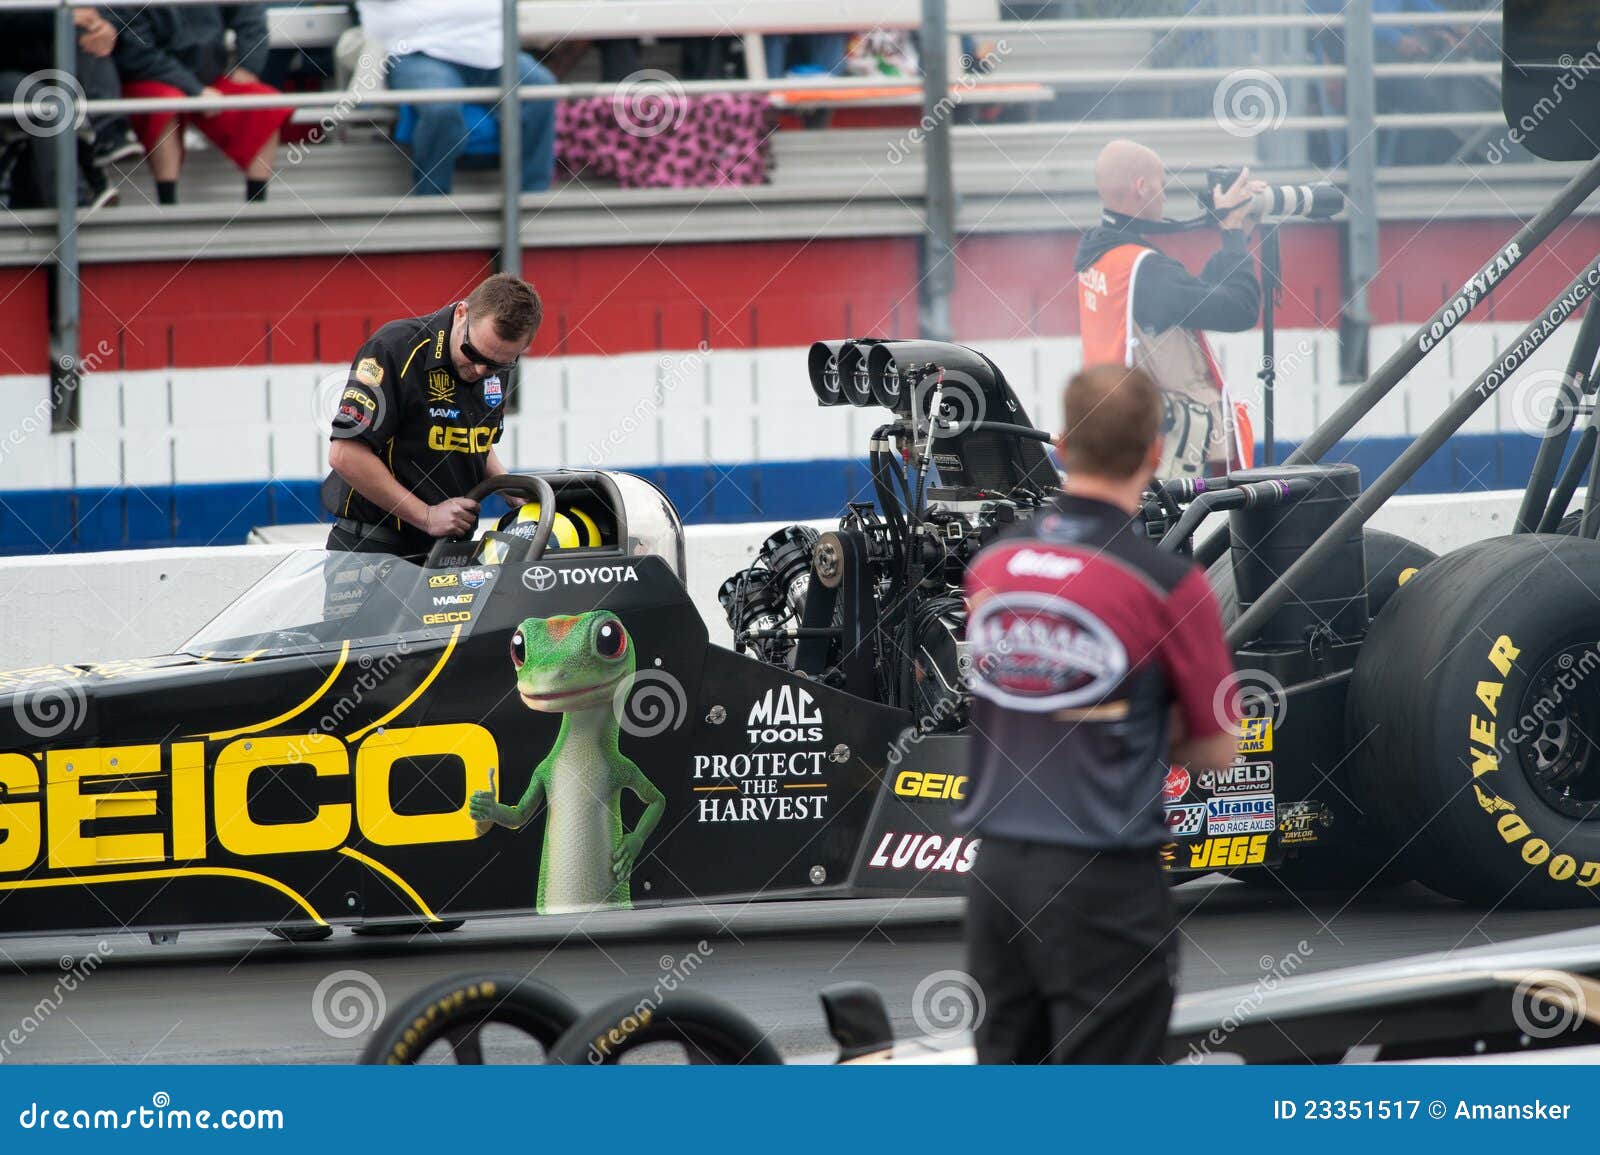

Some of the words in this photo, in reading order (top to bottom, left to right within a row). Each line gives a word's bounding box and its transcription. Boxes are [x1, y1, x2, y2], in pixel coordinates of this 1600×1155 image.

[1418, 241, 1522, 353] GOODYEAR
[1475, 262, 1600, 398] TOYOTARACING.C
[435, 330, 445, 359] GEICO
[428, 425, 498, 453] GEIC
[558, 566, 639, 585] TOYOTA
[433, 594, 474, 605] MAVTV
[423, 611, 471, 624] GEICO
[748, 685, 822, 726] MAC
[747, 728, 823, 743] TOOLS
[693, 752, 826, 778] PROTECT
[1216, 765, 1270, 784] WELD
[741, 779, 778, 794] THE
[894, 770, 969, 800] GEIC
[1217, 783, 1270, 792] RACING
[698, 795, 827, 822] HARVEST
[1208, 799, 1273, 818] Strange
[1209, 823, 1225, 833] PRO
[1228, 821, 1248, 832] RACE
[1250, 820, 1274, 830] AXLES
[1284, 831, 1313, 839] TAYLOR
[868, 832, 983, 874] LUCAS
[1189, 835, 1268, 868] JEGS
